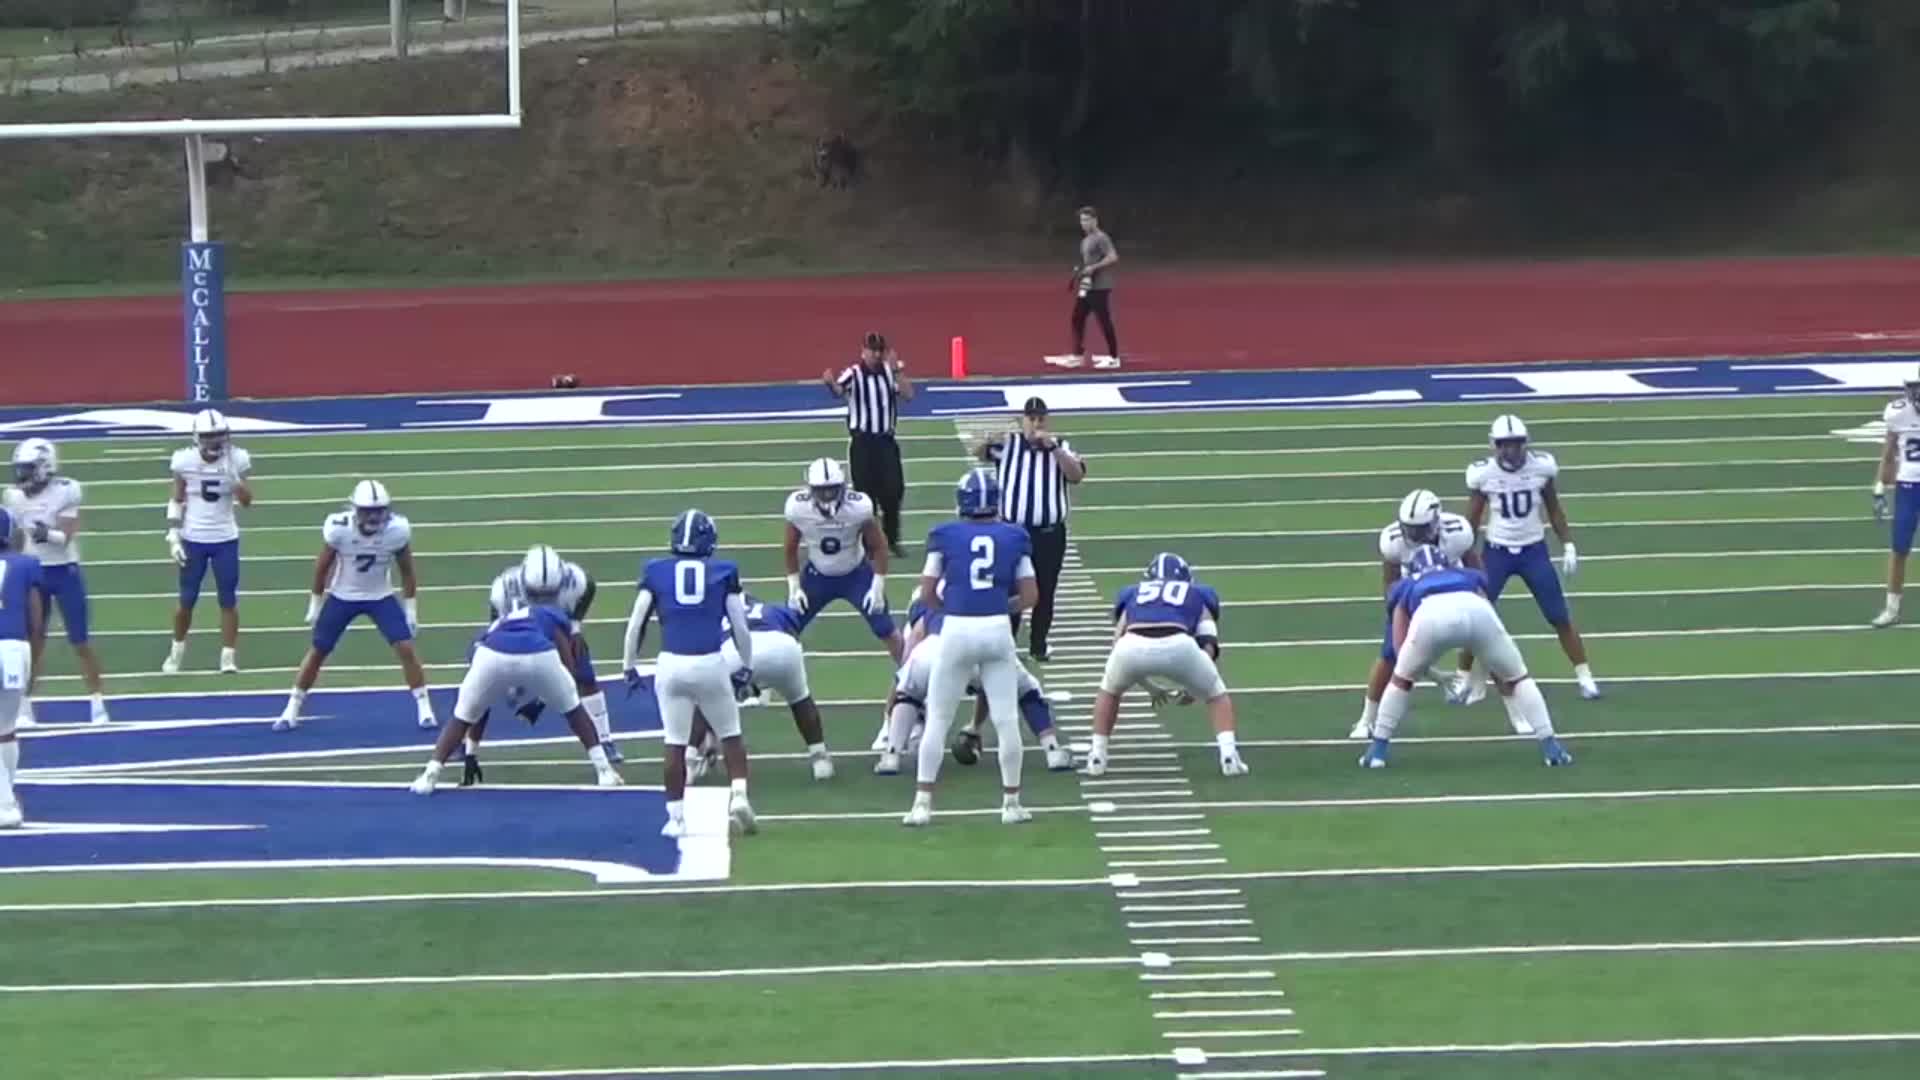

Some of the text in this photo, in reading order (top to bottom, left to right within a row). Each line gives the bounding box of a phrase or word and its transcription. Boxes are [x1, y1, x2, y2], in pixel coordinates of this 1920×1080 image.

[201, 480, 221, 503] 5
[1499, 489, 1533, 519] 10
[355, 554, 377, 573] 7
[970, 535, 995, 590] 2
[675, 559, 705, 605] 0
[1136, 580, 1190, 606] 50
